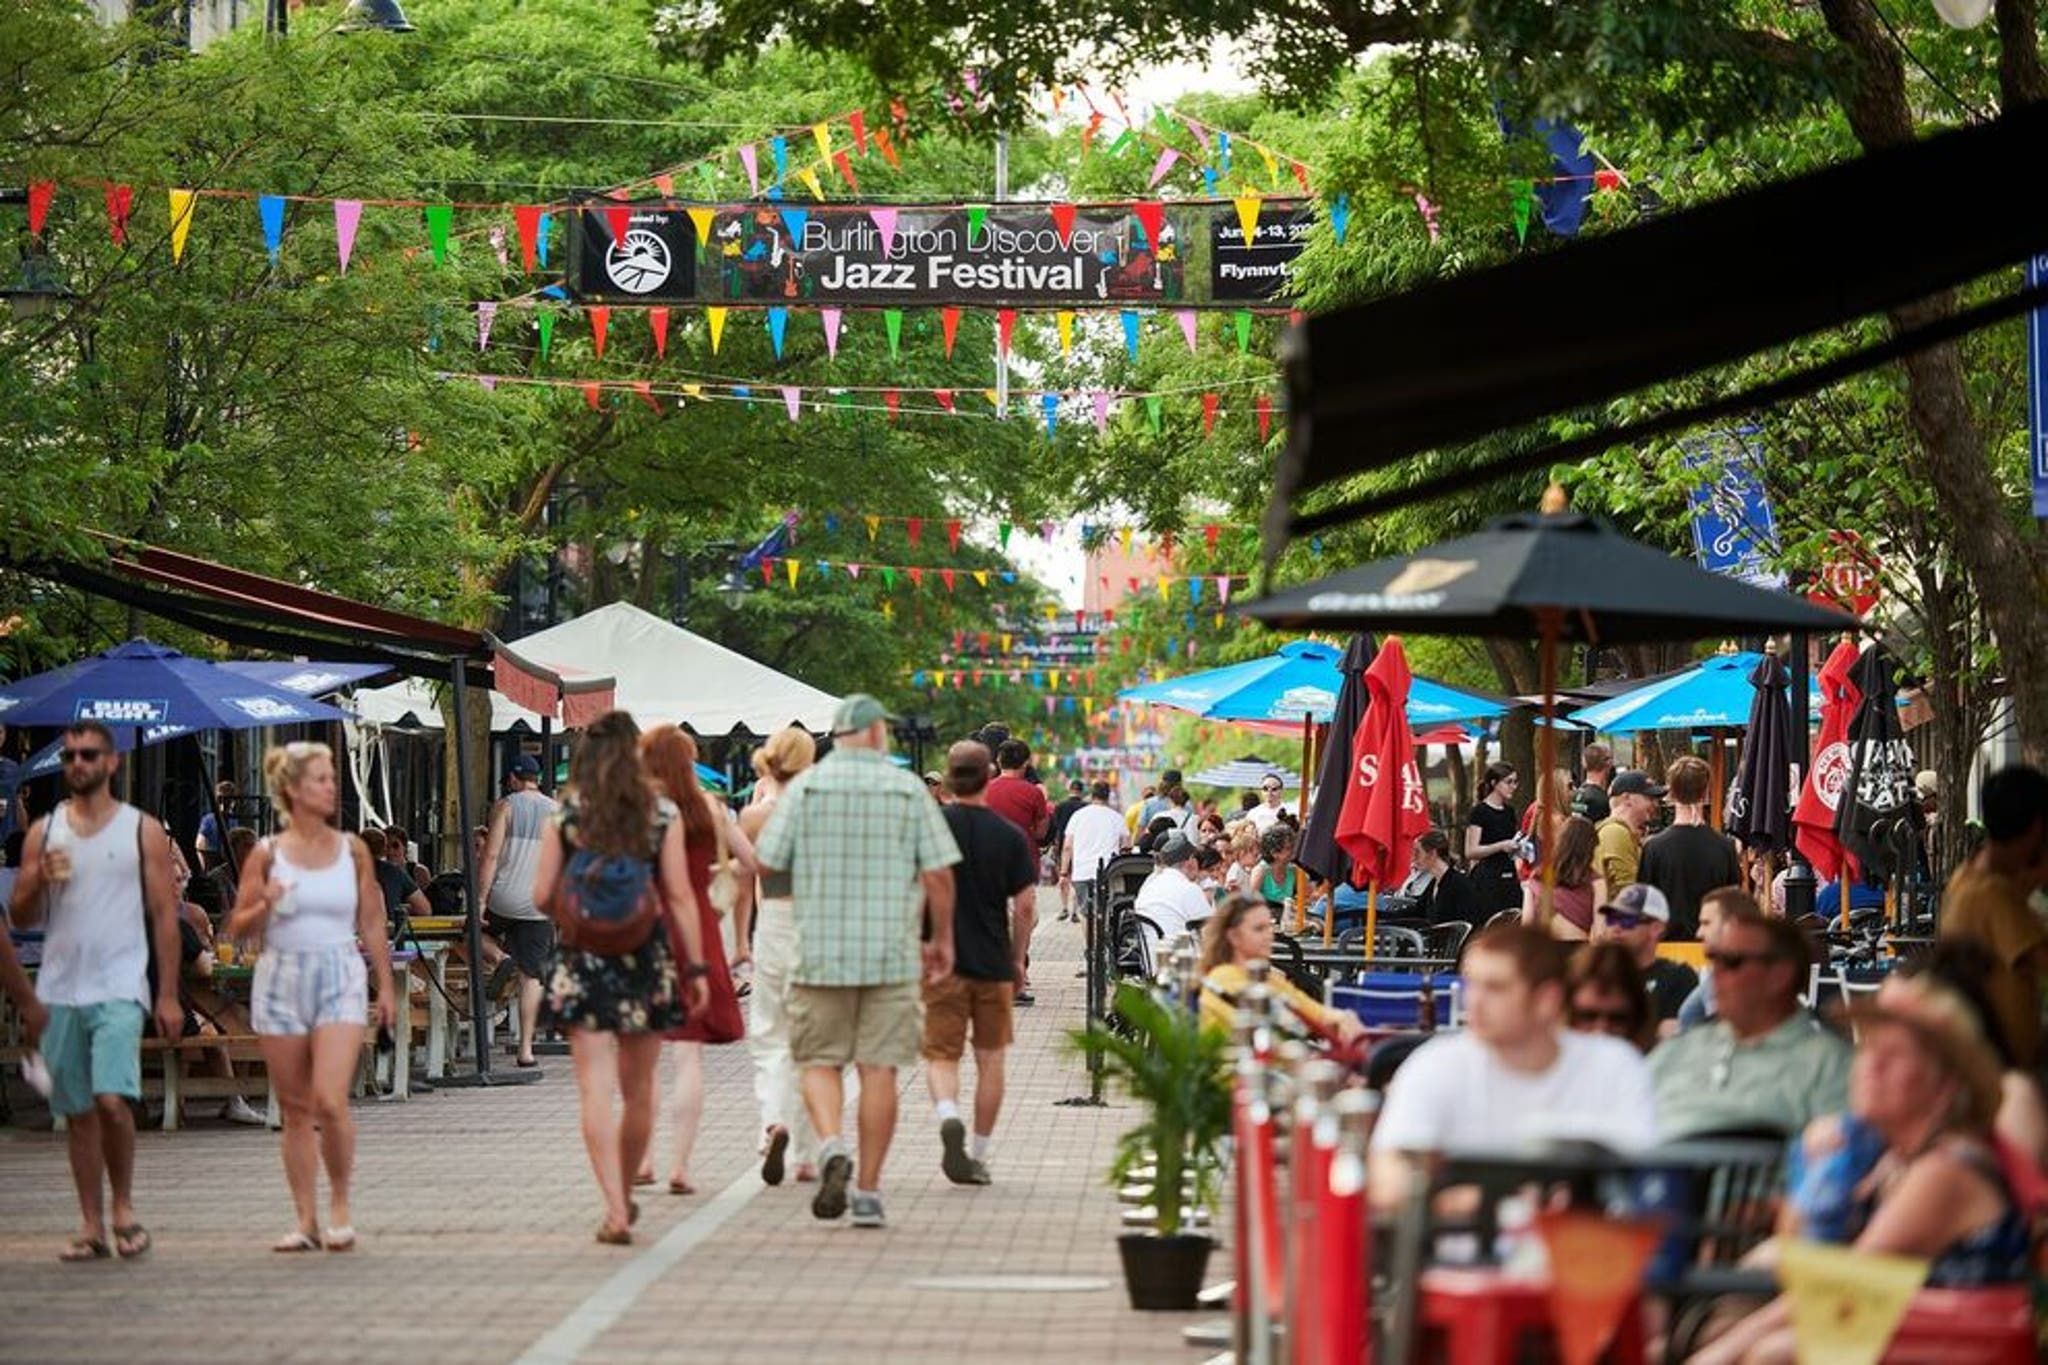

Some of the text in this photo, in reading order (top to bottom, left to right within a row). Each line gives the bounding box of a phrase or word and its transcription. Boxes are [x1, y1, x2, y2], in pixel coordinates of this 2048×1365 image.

[804, 221, 1104, 260] Burlington Discover
[821, 255, 1083, 290] Jazz Festival
[80, 709, 161, 719] LIGHT
[94, 701, 152, 711] BUD
